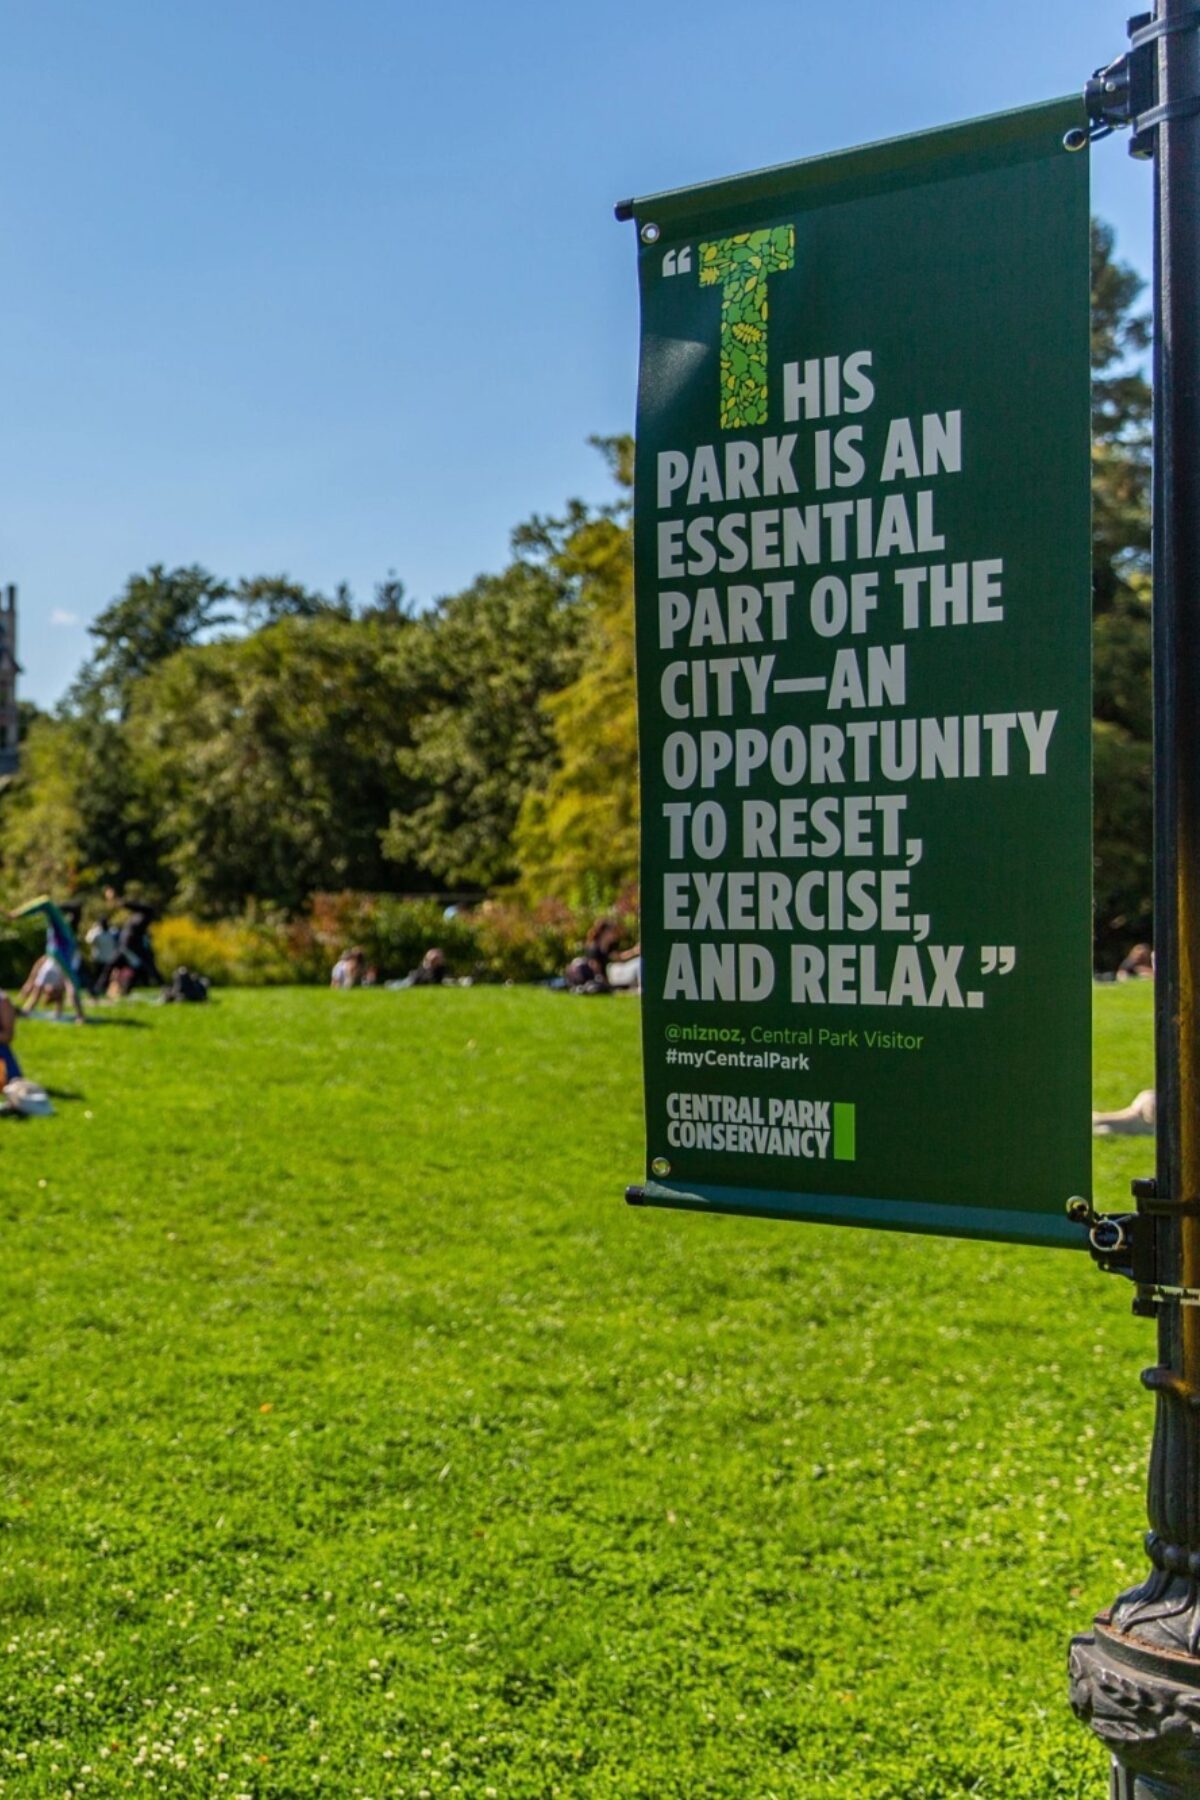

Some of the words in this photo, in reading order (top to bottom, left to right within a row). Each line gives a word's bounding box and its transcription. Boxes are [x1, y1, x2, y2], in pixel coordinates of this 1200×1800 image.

[658, 434, 799, 508] PARK
[815, 425, 865, 490] IS
[880, 410, 961, 481] AN
[658, 490, 945, 578] ESSENTIAL
[659, 581, 794, 649] PART
[811, 572, 878, 637] OF
[895, 558, 1003, 629] THE
[663, 710, 1058, 789] OPPORTUNITY
[663, 801, 726, 859] TO
[743, 795, 922, 866] RESET,
[664, 870, 929, 942] EXERCISE,
[663, 944, 775, 1001] AND
[791, 945, 1015, 1008] RELAX.”
[665, 1025, 745, 1044] @niznoz,
[751, 1026, 812, 1044] Central
[819, 1029, 858, 1046] Park
[864, 1031, 923, 1049] Visitor
[666, 1049, 809, 1070] #myCentralPark
[667, 1093, 764, 1124] CENTRAL
[769, 1099, 830, 1129] PARK
[668, 1121, 830, 1158] CONSERVANCY
